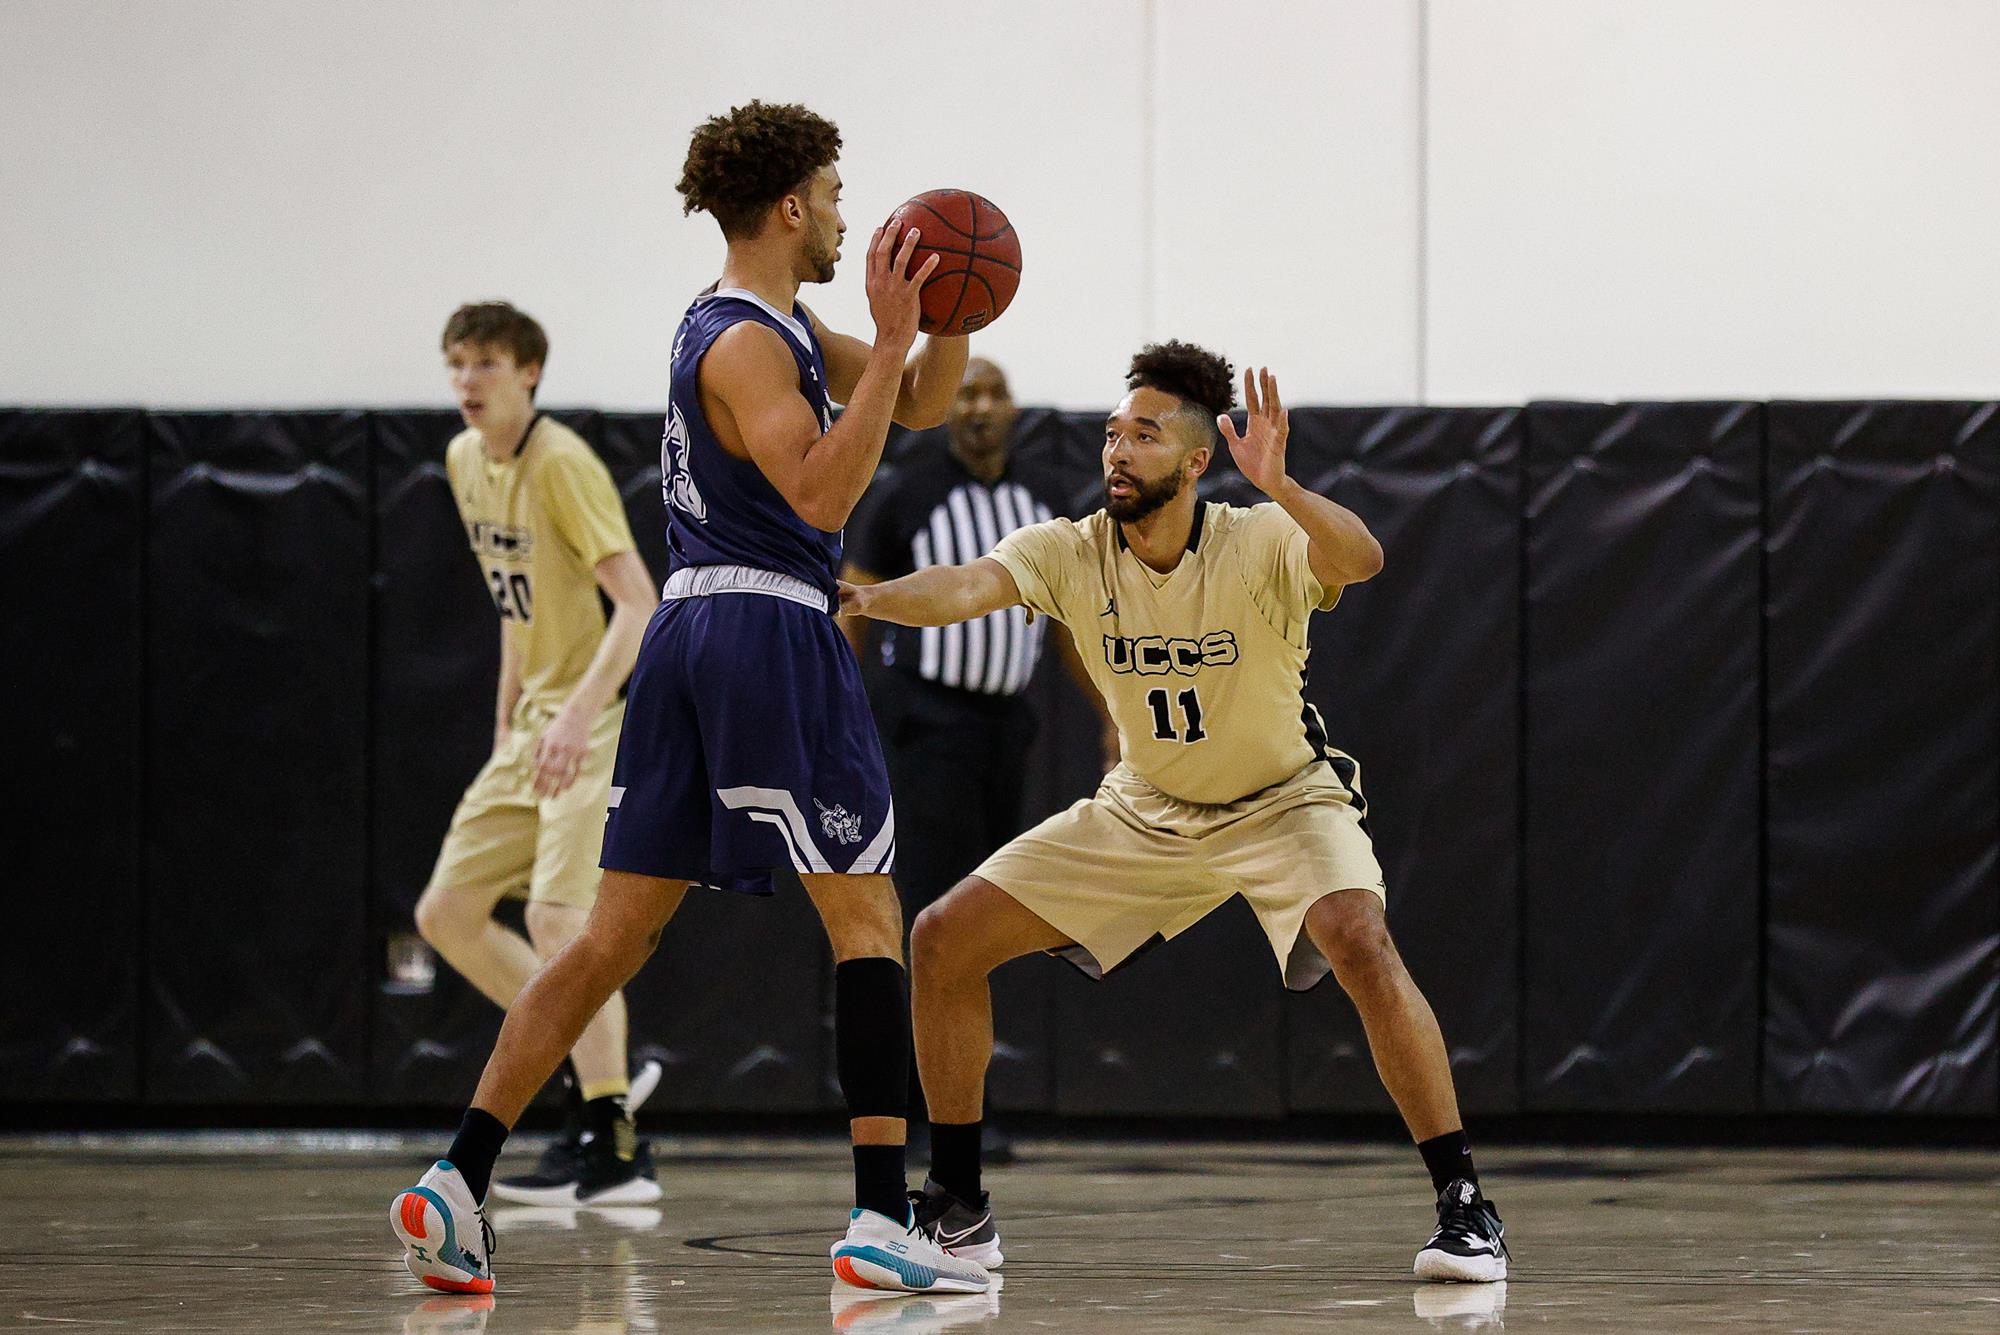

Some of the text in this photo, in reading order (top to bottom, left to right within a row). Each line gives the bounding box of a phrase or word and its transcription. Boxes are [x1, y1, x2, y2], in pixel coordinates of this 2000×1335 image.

[490, 566, 534, 627] 20
[1103, 630, 1239, 676] UCCS
[1146, 685, 1208, 745] 11
